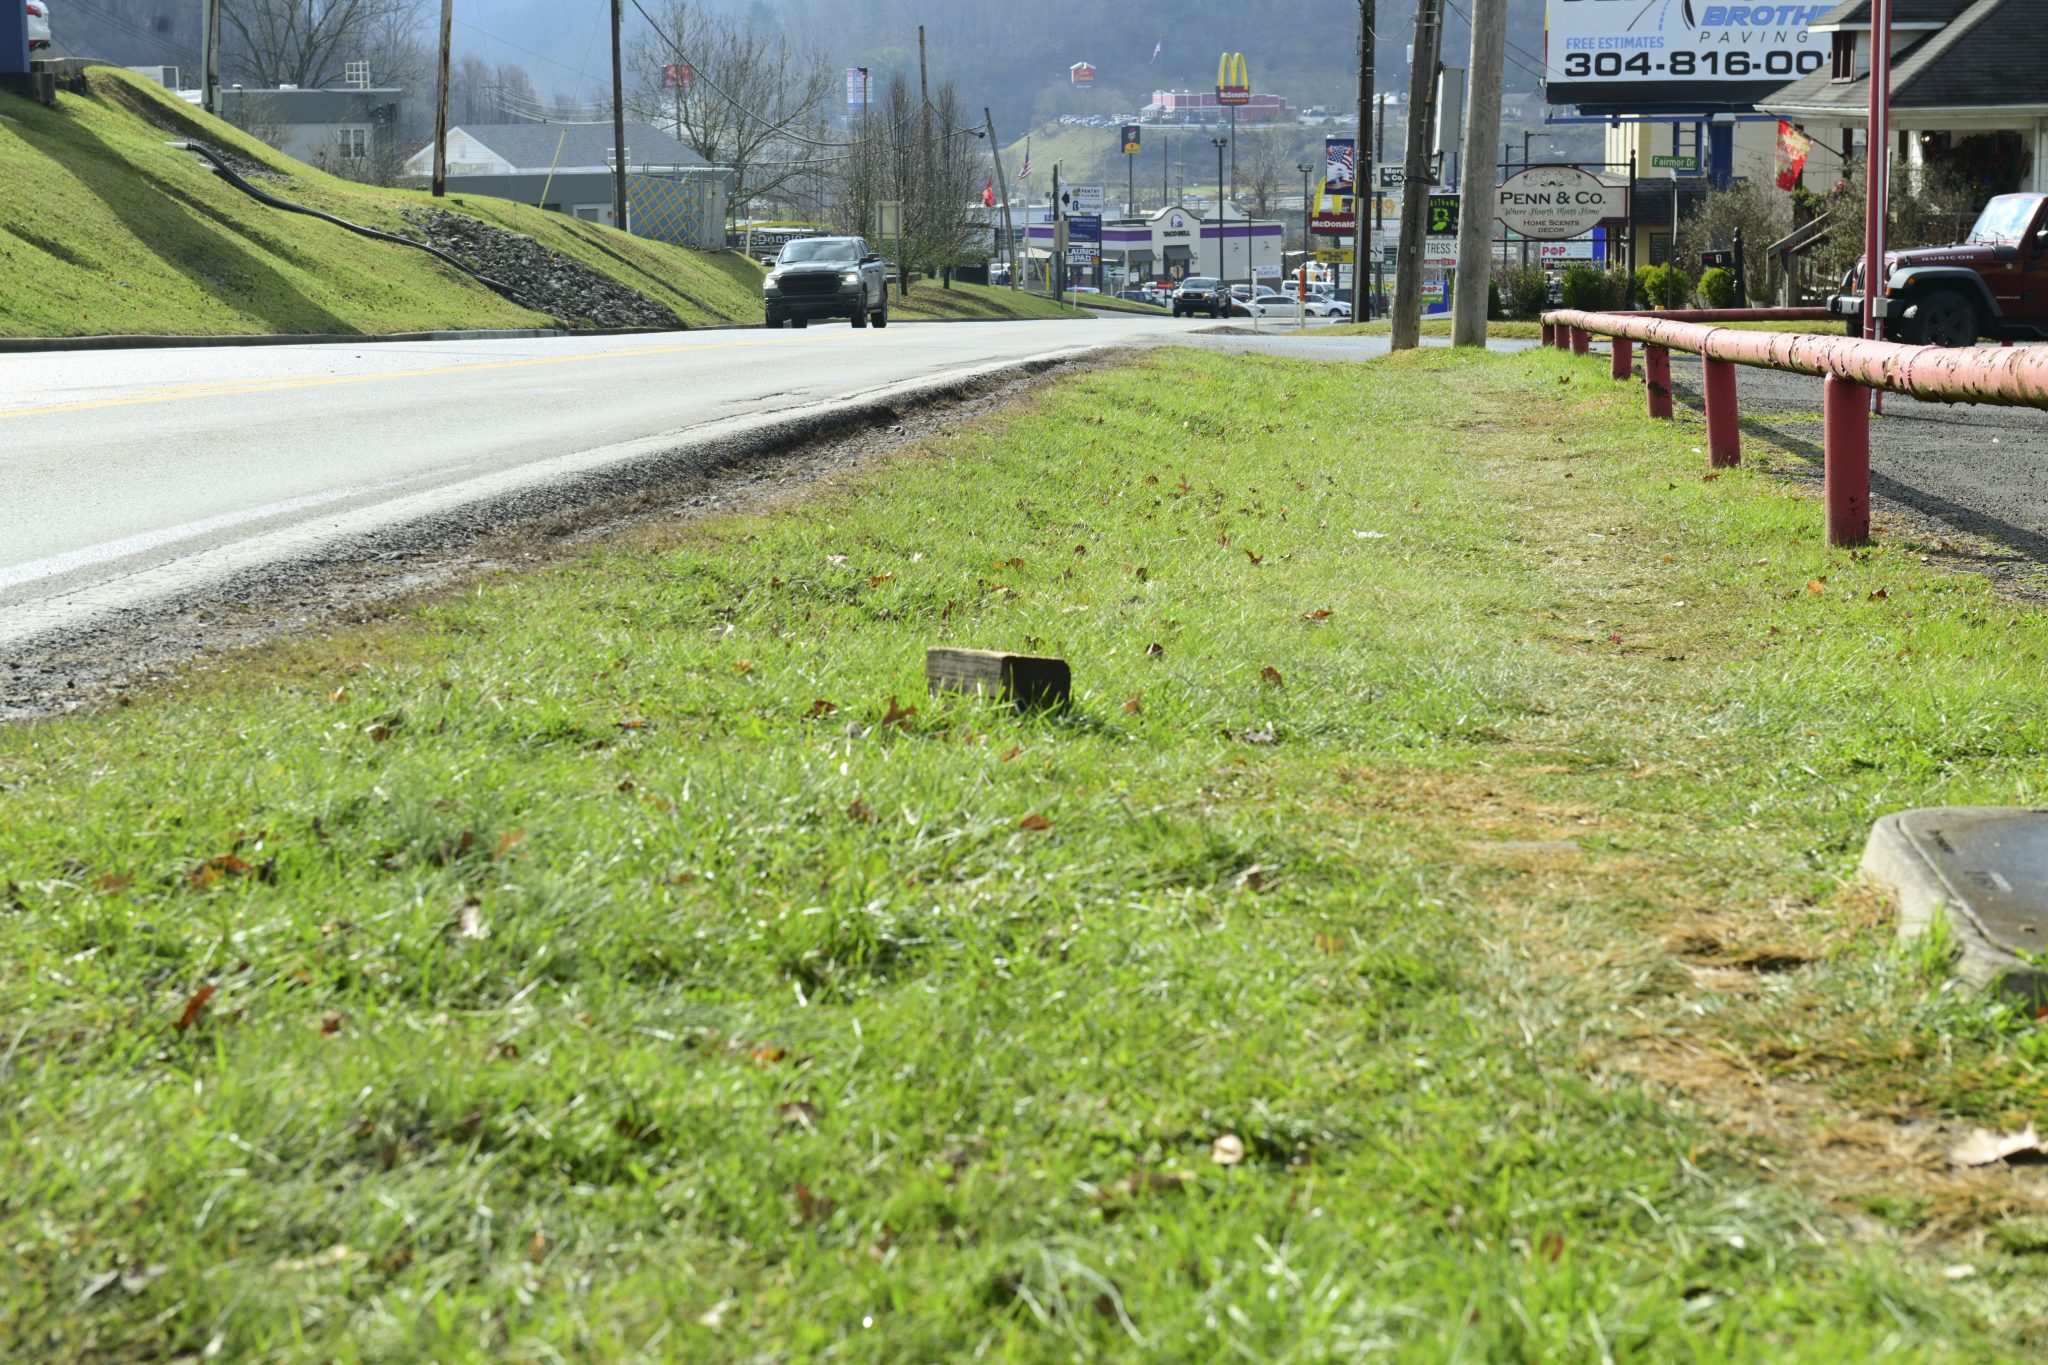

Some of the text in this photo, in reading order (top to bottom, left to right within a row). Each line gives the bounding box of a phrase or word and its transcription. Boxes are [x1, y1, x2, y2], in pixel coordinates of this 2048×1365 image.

[1566, 36, 1665, 49] FREE ESTIMATES
[1700, 31, 1808, 43] PAVING
[1564, 51, 1831, 77] 304-816-00
[1654, 157, 1696, 167] Fairmor Dr
[1500, 192, 1551, 205] PENN
[1556, 191, 1571, 205] &
[1556, 207, 1577, 216] Meets
[1067, 248, 1100, 257] LAUNCH
